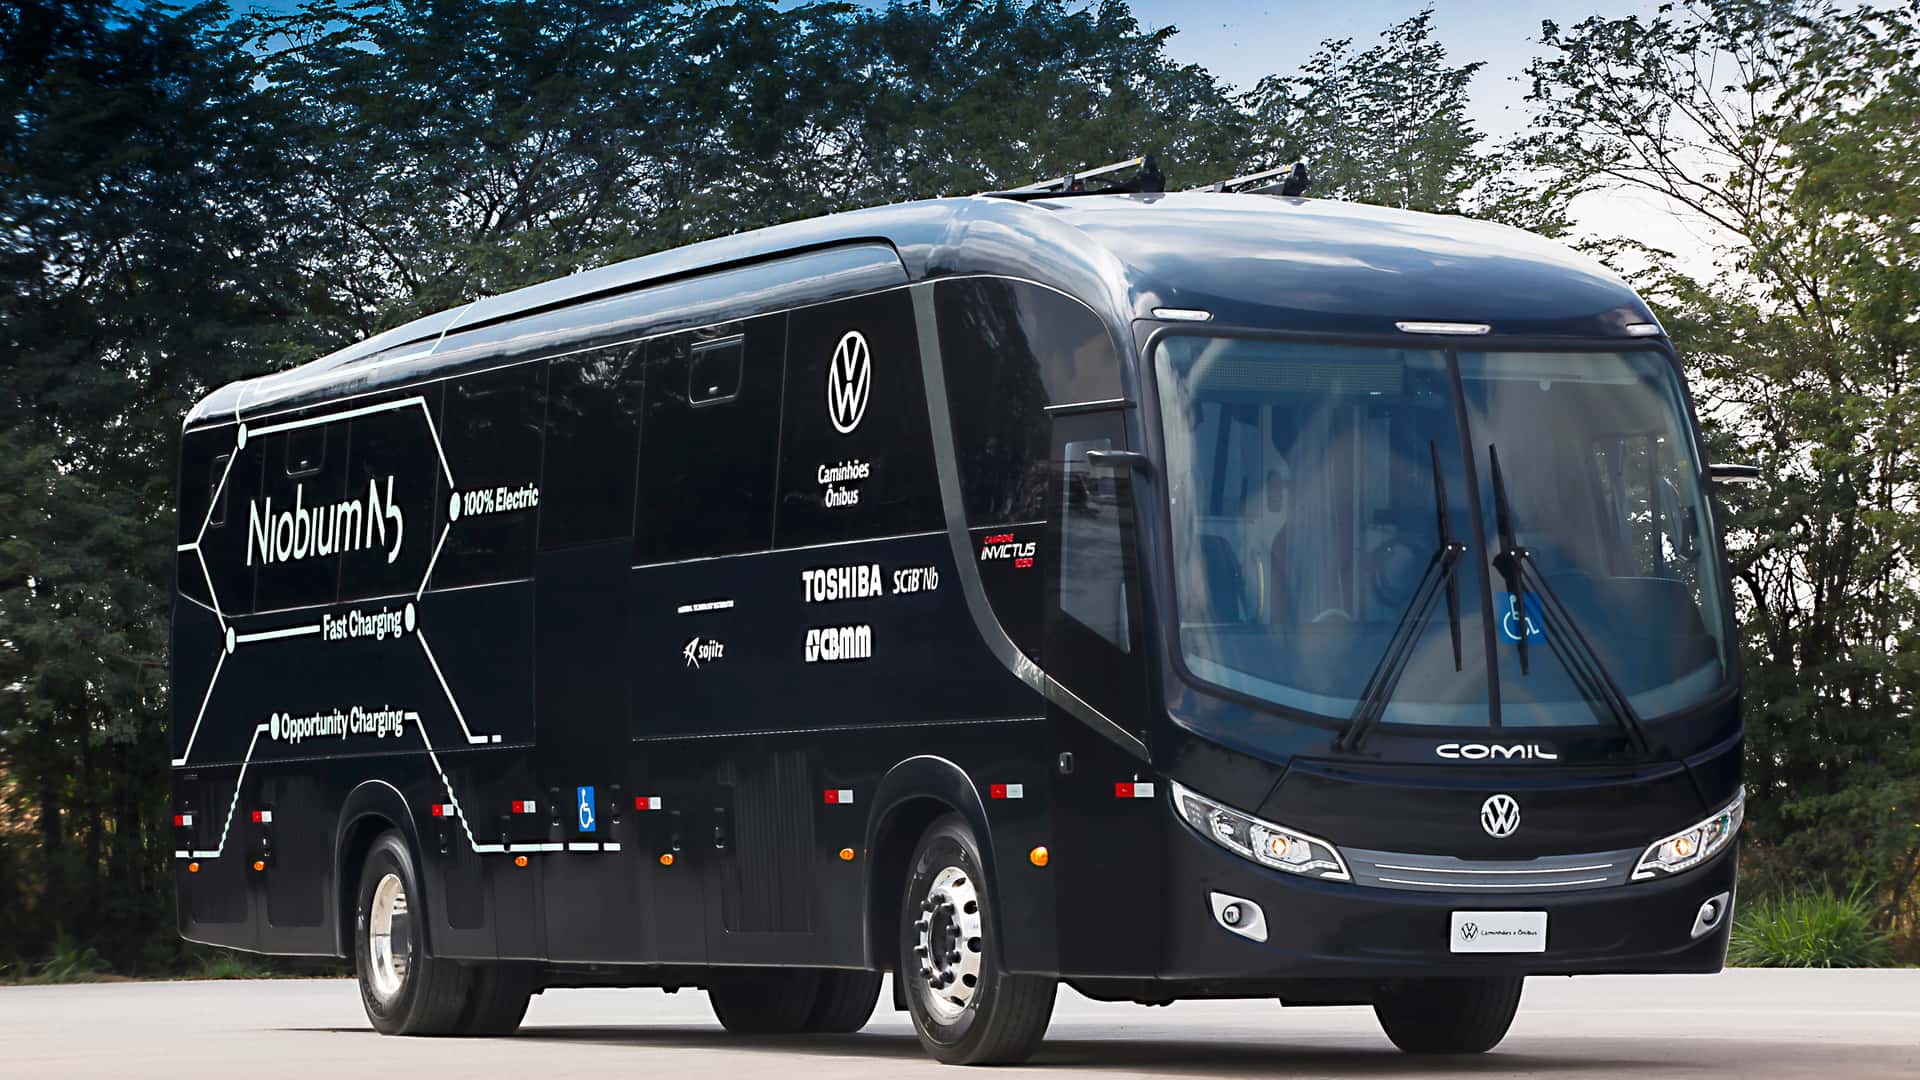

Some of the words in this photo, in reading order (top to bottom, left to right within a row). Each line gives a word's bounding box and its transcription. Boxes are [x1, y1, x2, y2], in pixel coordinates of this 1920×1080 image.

[818, 459, 870, 484] Caminhões
[464, 488, 494, 516] 100%
[496, 482, 539, 512] Electric
[825, 483, 859, 508] Ônibus
[981, 542, 1036, 560] INVICTUS
[802, 564, 883, 602] TOSHIBA
[323, 614, 347, 640] Fast
[349, 606, 402, 640] Charging
[698, 640, 724, 662] sojitz
[281, 706, 348, 744] Opportunity
[350, 704, 403, 738] Charging
[1436, 744, 1558, 760] COMIL
